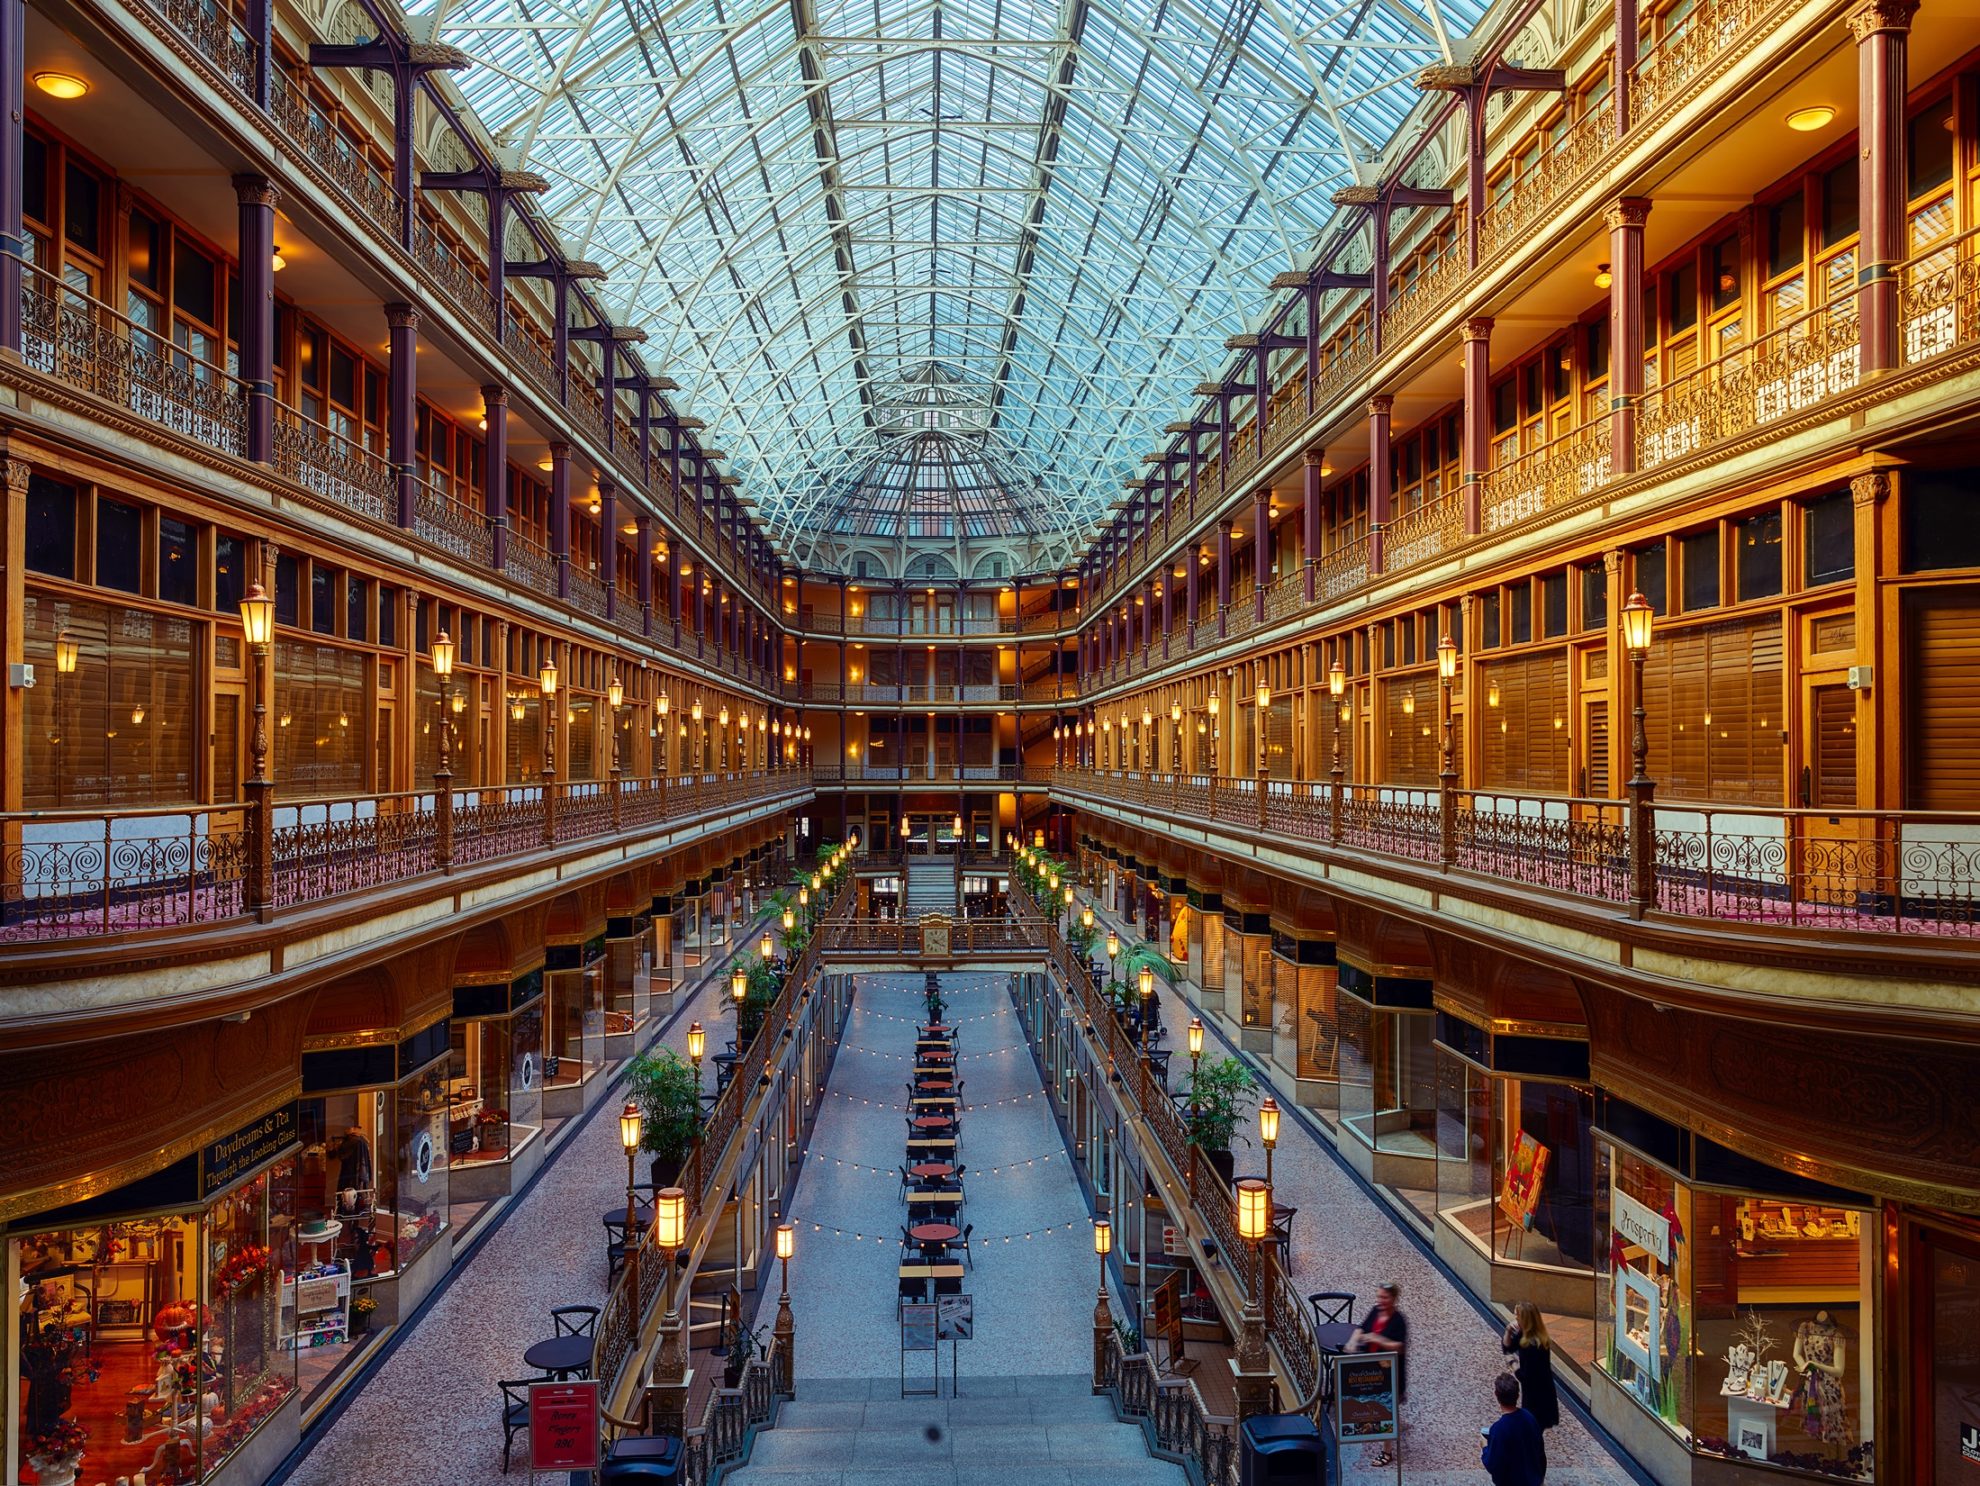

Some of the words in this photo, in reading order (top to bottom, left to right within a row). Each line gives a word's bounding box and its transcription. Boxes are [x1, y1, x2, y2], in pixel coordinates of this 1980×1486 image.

[206, 1160, 237, 1188] Through
[239, 1155, 250, 1168] the
[251, 1139, 277, 1162] Looking
[277, 1129, 296, 1145] Glass
[215, 1126, 264, 1162] Daydreams
[264, 1119, 274, 1134] &
[275, 1112, 289, 1128] Tea
[1962, 1428, 1980, 1449] J
